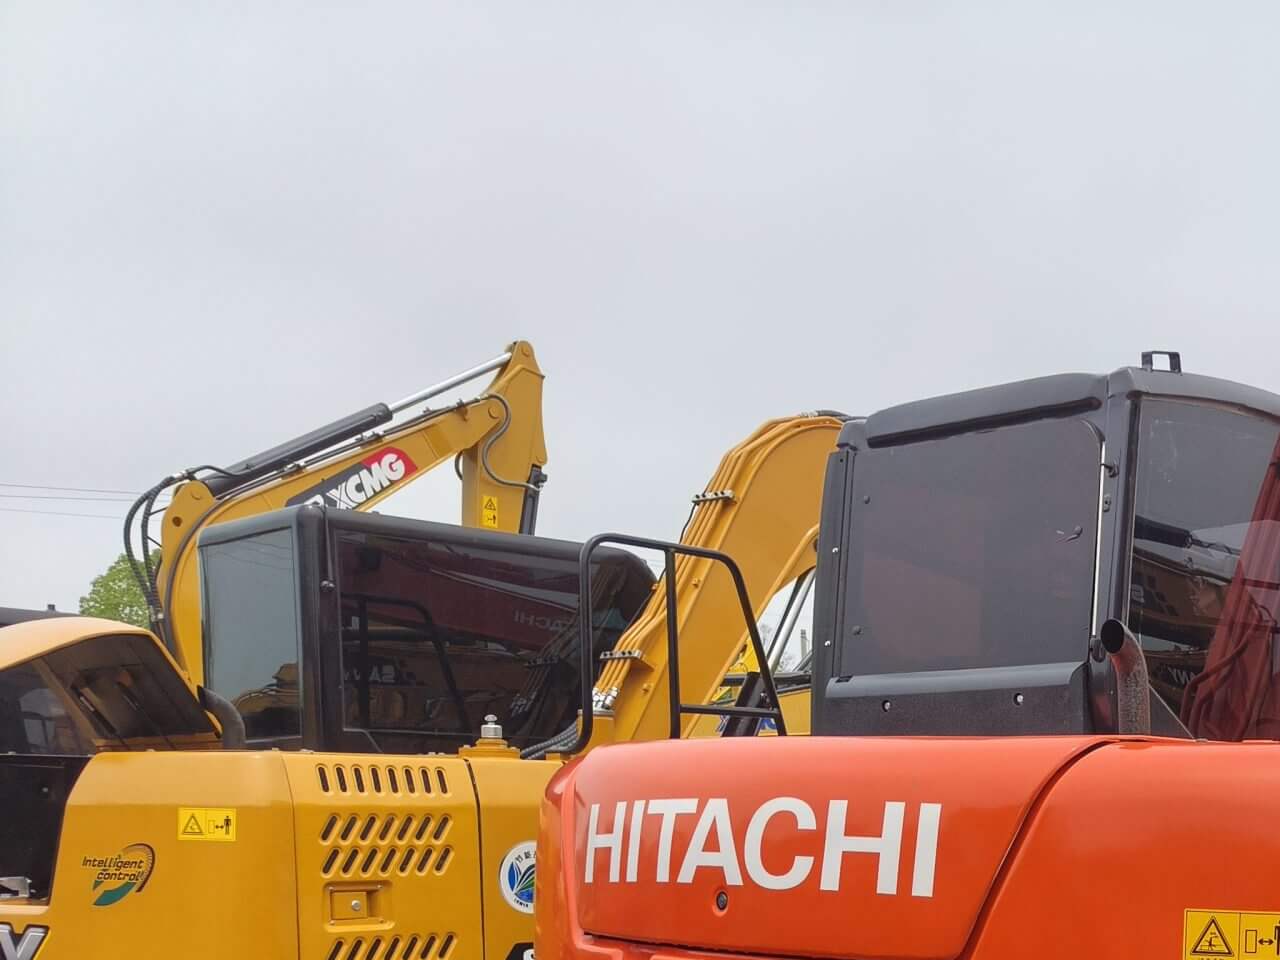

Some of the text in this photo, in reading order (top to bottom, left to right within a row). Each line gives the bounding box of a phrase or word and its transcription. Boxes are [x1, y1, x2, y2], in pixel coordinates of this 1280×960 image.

[326, 453, 405, 510] XCMG
[82, 854, 144, 870] Intelligent
[584, 796, 943, 898] HITACHI
